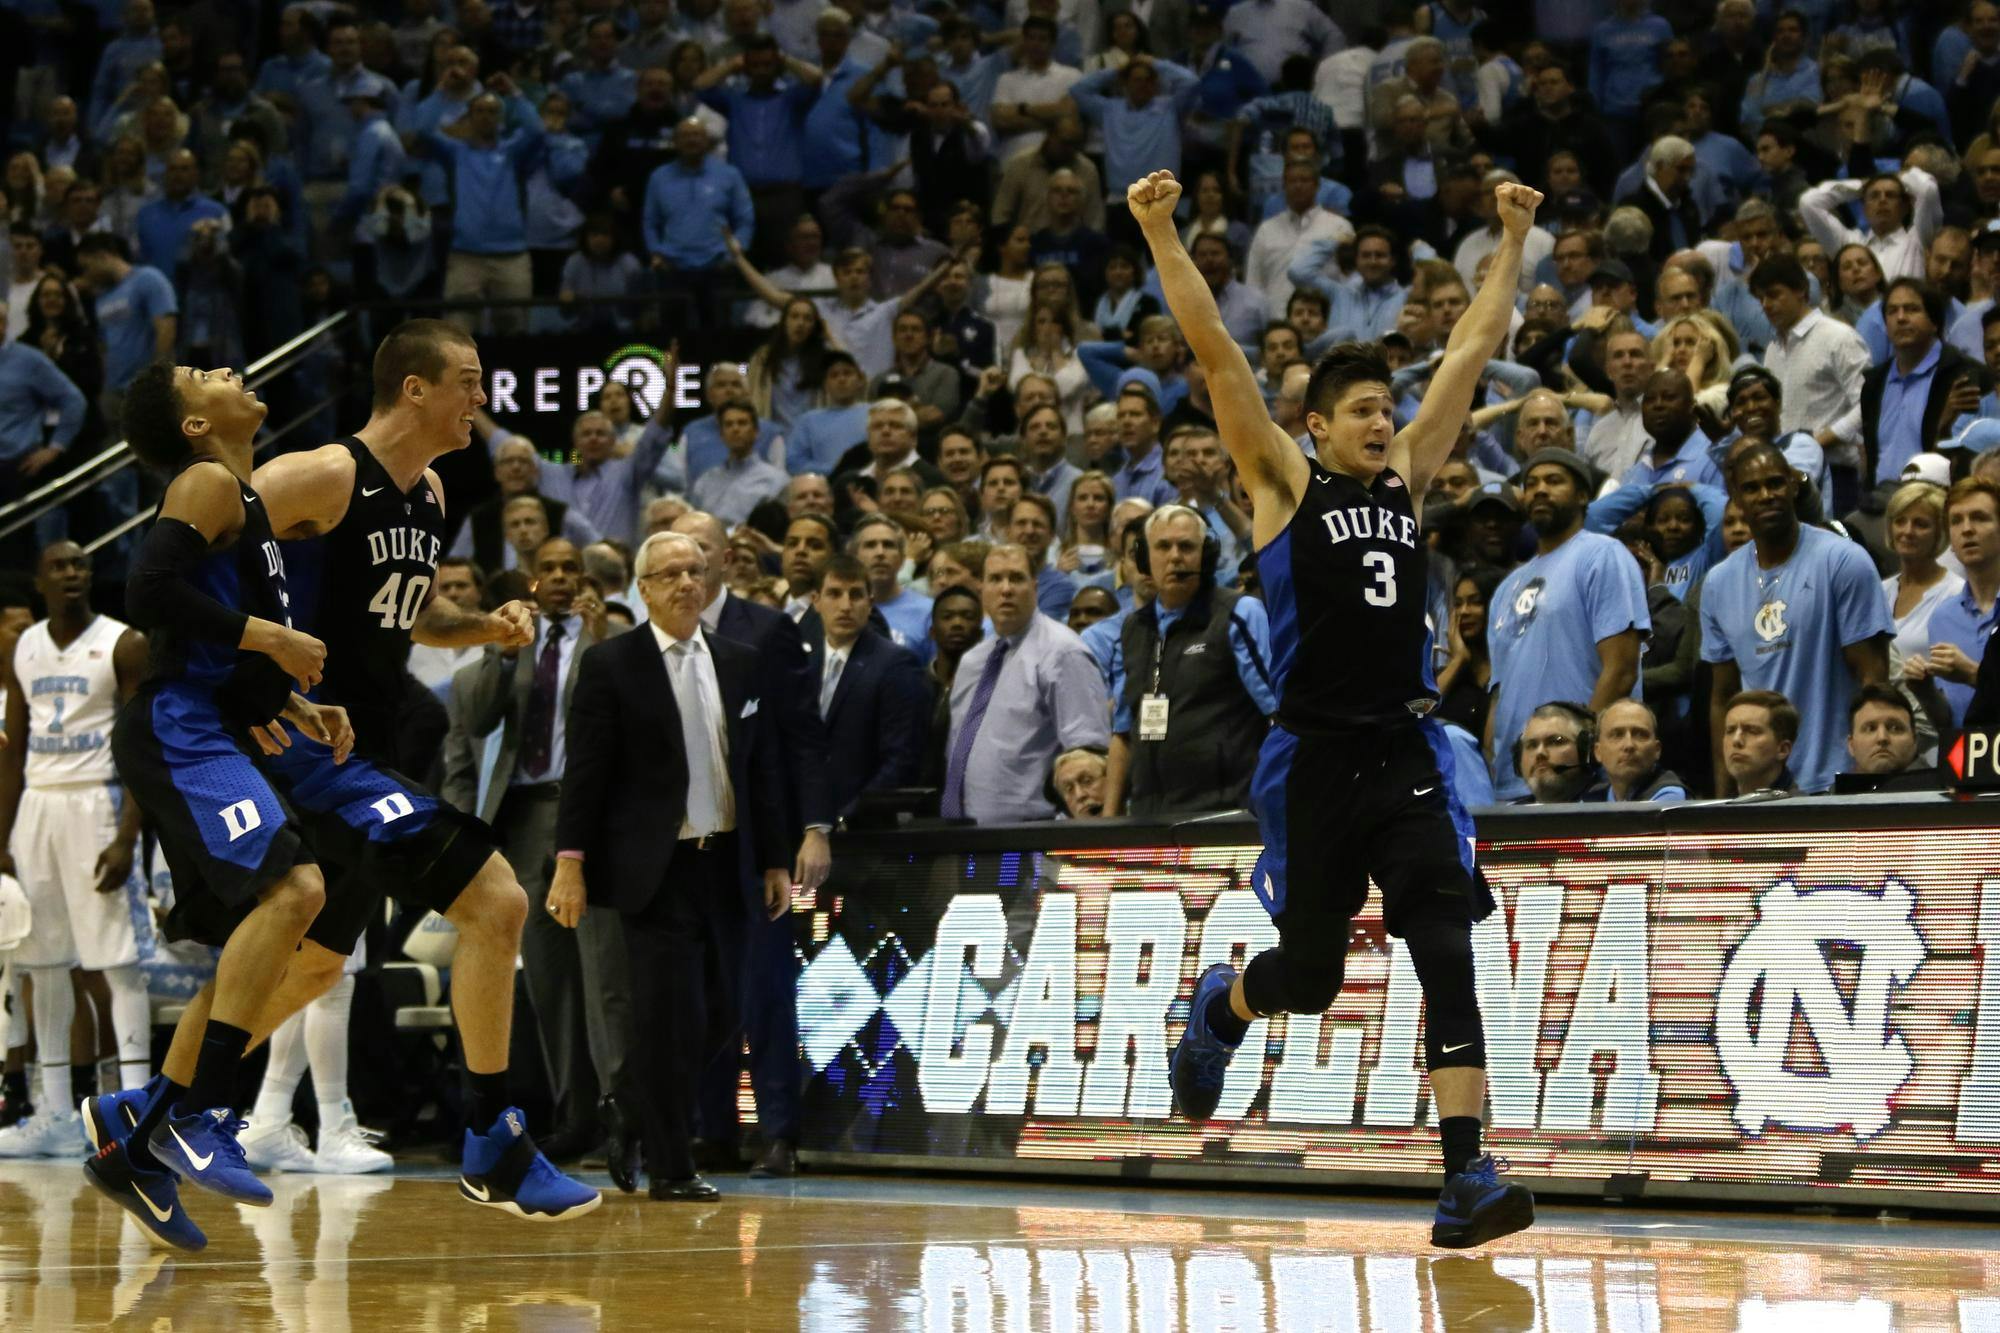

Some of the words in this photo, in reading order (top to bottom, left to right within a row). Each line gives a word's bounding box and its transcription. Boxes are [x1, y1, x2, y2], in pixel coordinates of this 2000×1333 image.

[367, 527, 441, 570] DUKE
[1321, 507, 1416, 549] DUKE
[1363, 551, 1397, 607] 3
[368, 572, 431, 630] 40
[27, 731, 105, 755] AROLINA
